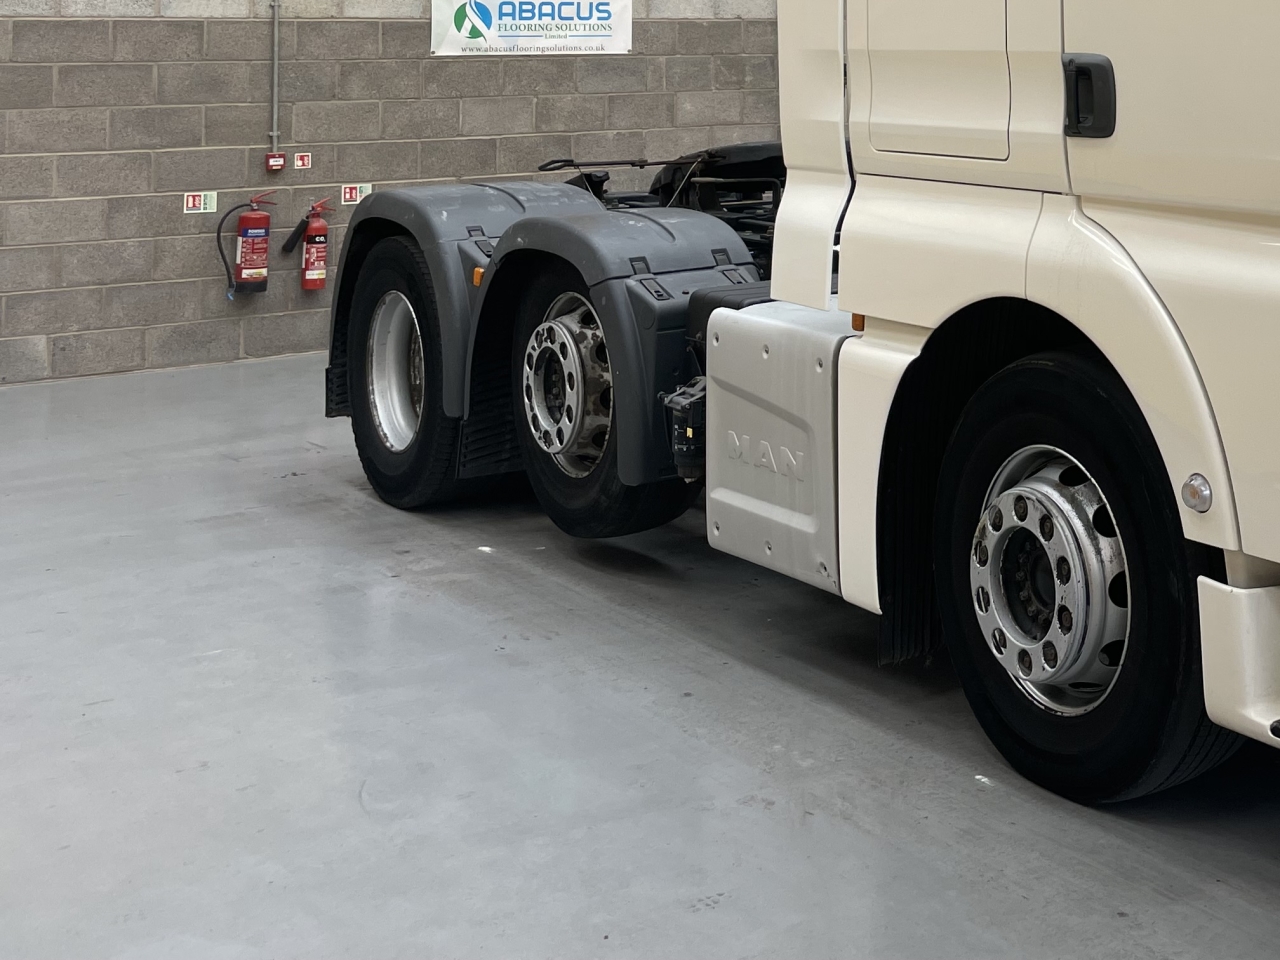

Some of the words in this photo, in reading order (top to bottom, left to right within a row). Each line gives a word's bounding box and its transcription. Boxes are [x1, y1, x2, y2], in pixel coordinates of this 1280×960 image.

[498, 1, 612, 21] ABACUS
[497, 23, 553, 32] FLOORING
[554, 23, 613, 32] SOLUTIONS
[460, 43, 606, 54] www.abacusflooringsolutions.co.uk
[728, 430, 804, 482] MAN
